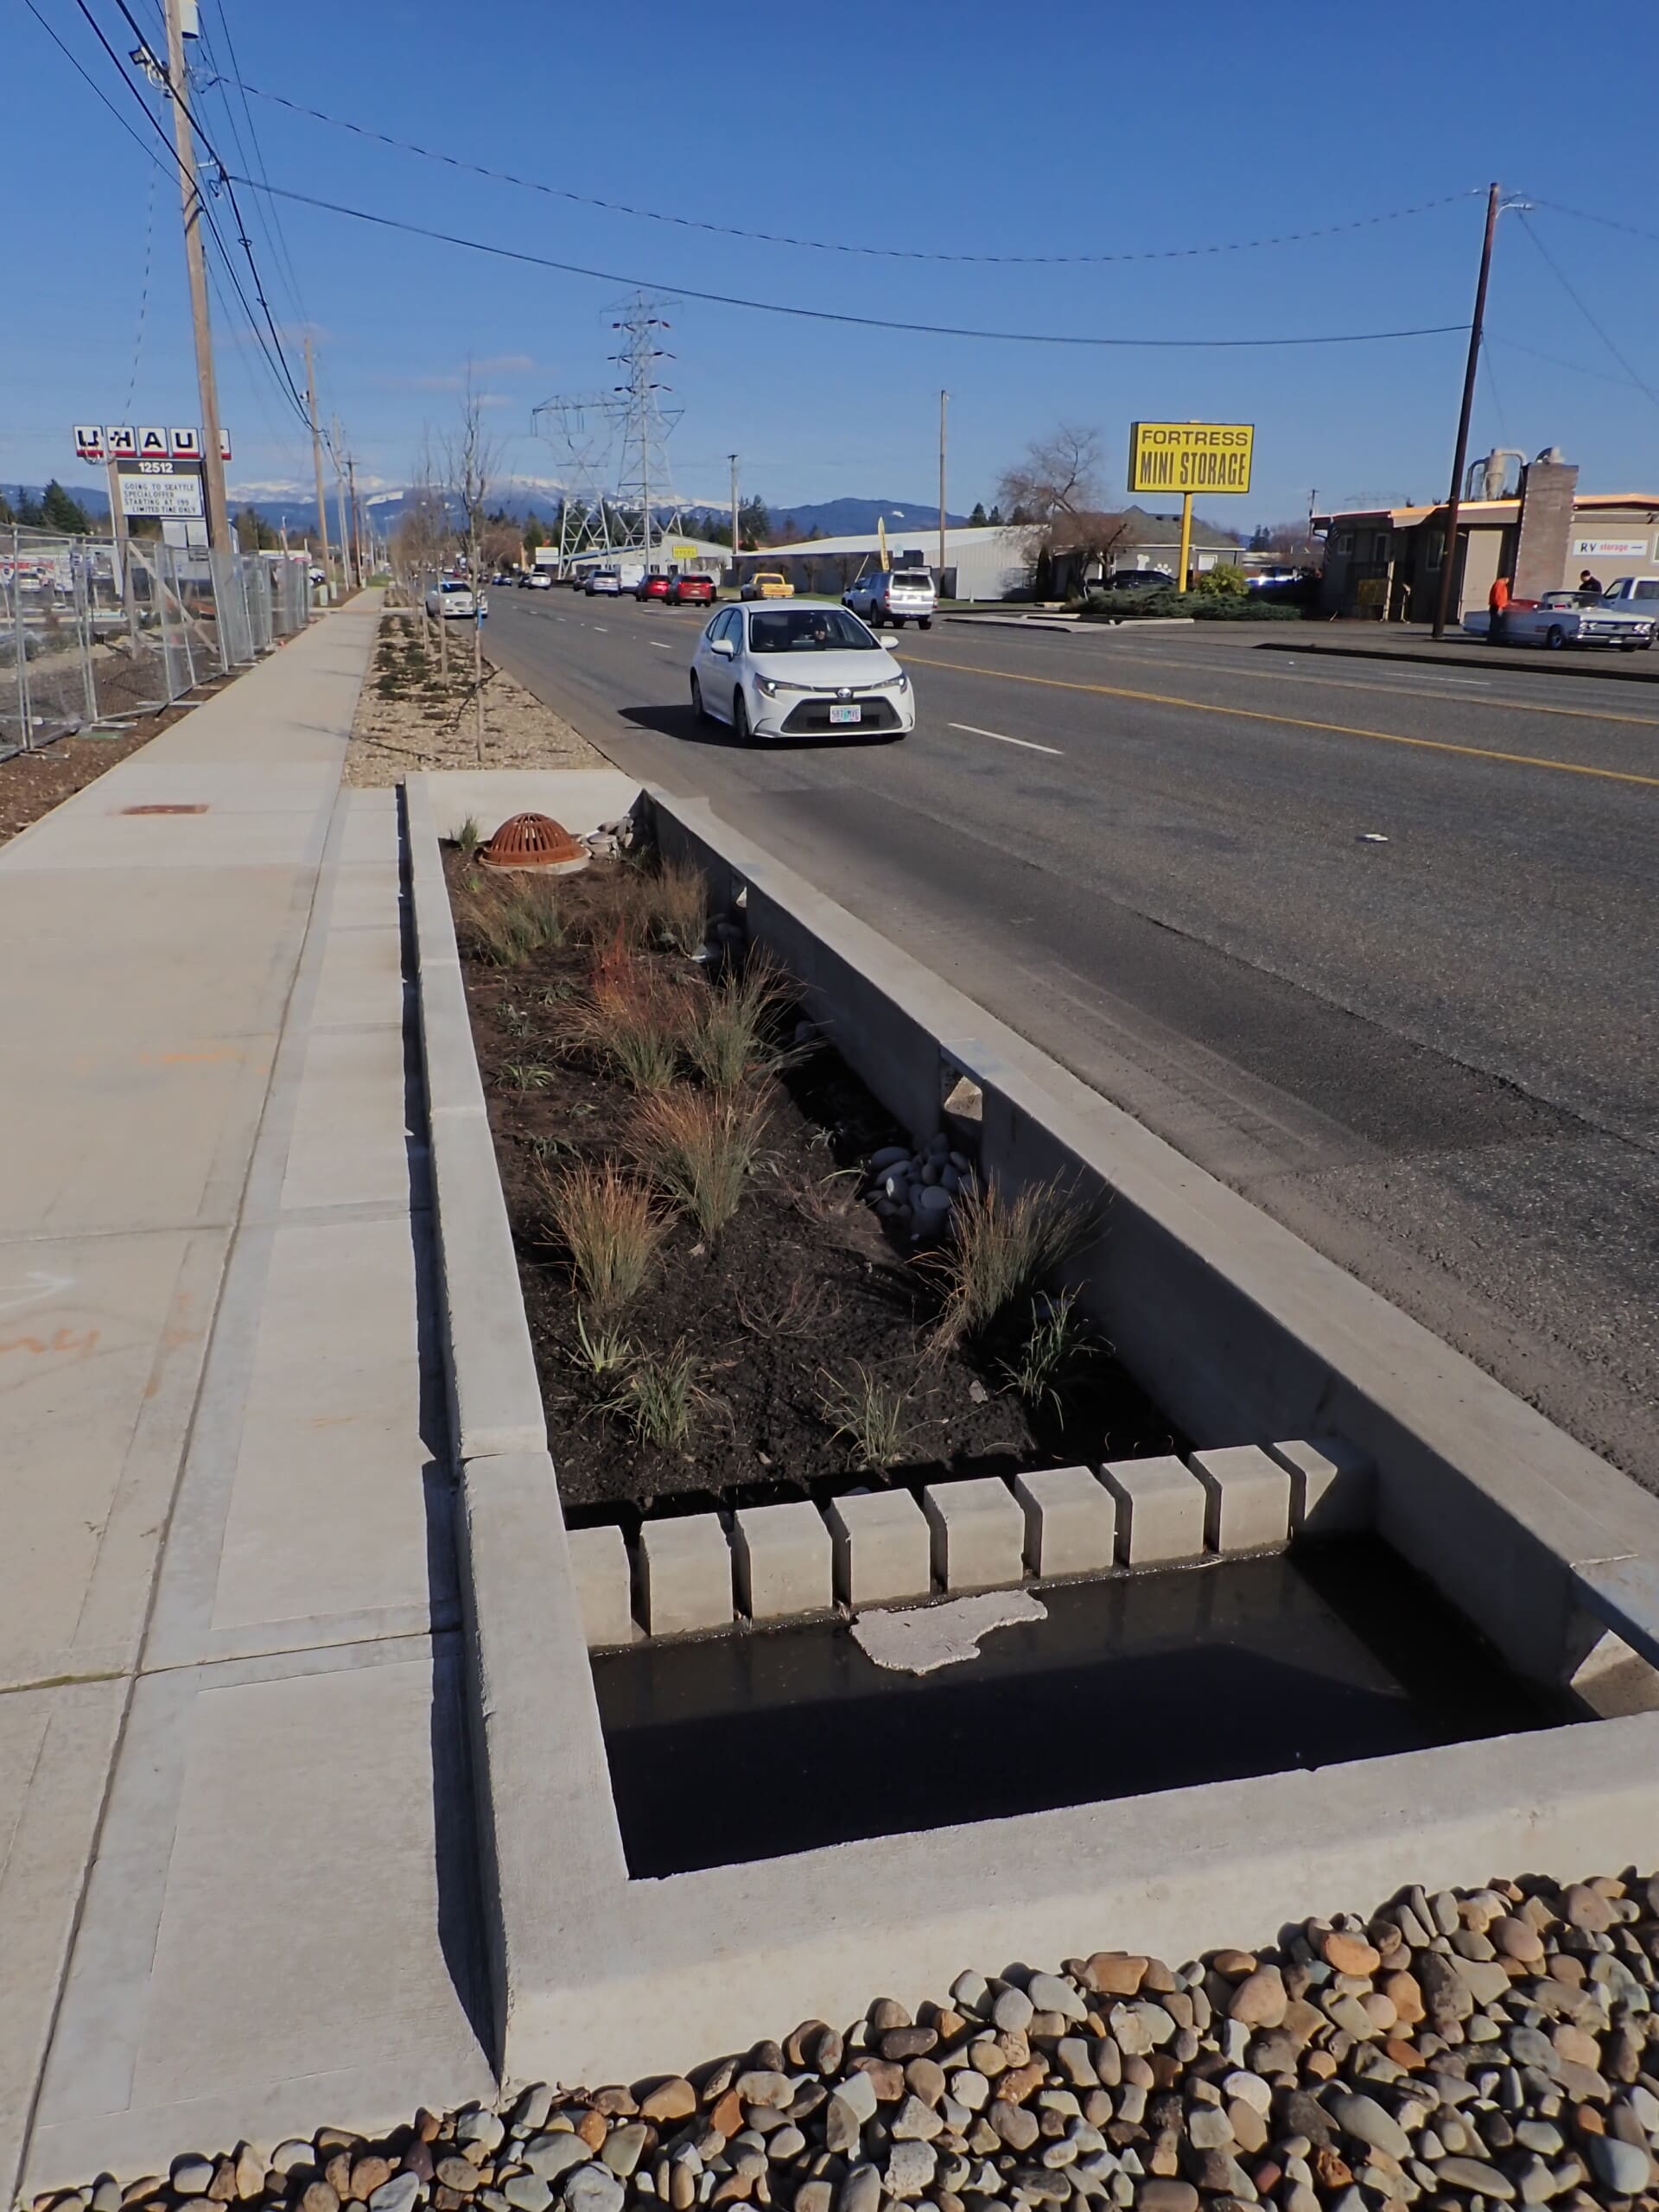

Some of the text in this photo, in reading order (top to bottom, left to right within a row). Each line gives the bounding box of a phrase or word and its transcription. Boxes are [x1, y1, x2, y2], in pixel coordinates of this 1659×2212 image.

[1142, 430, 1248, 446] FORTRESS
[138, 462, 174, 474] 12512
[1141, 451, 1246, 485] MINI STORAGE
[1580, 542, 1629, 553] RV storage
